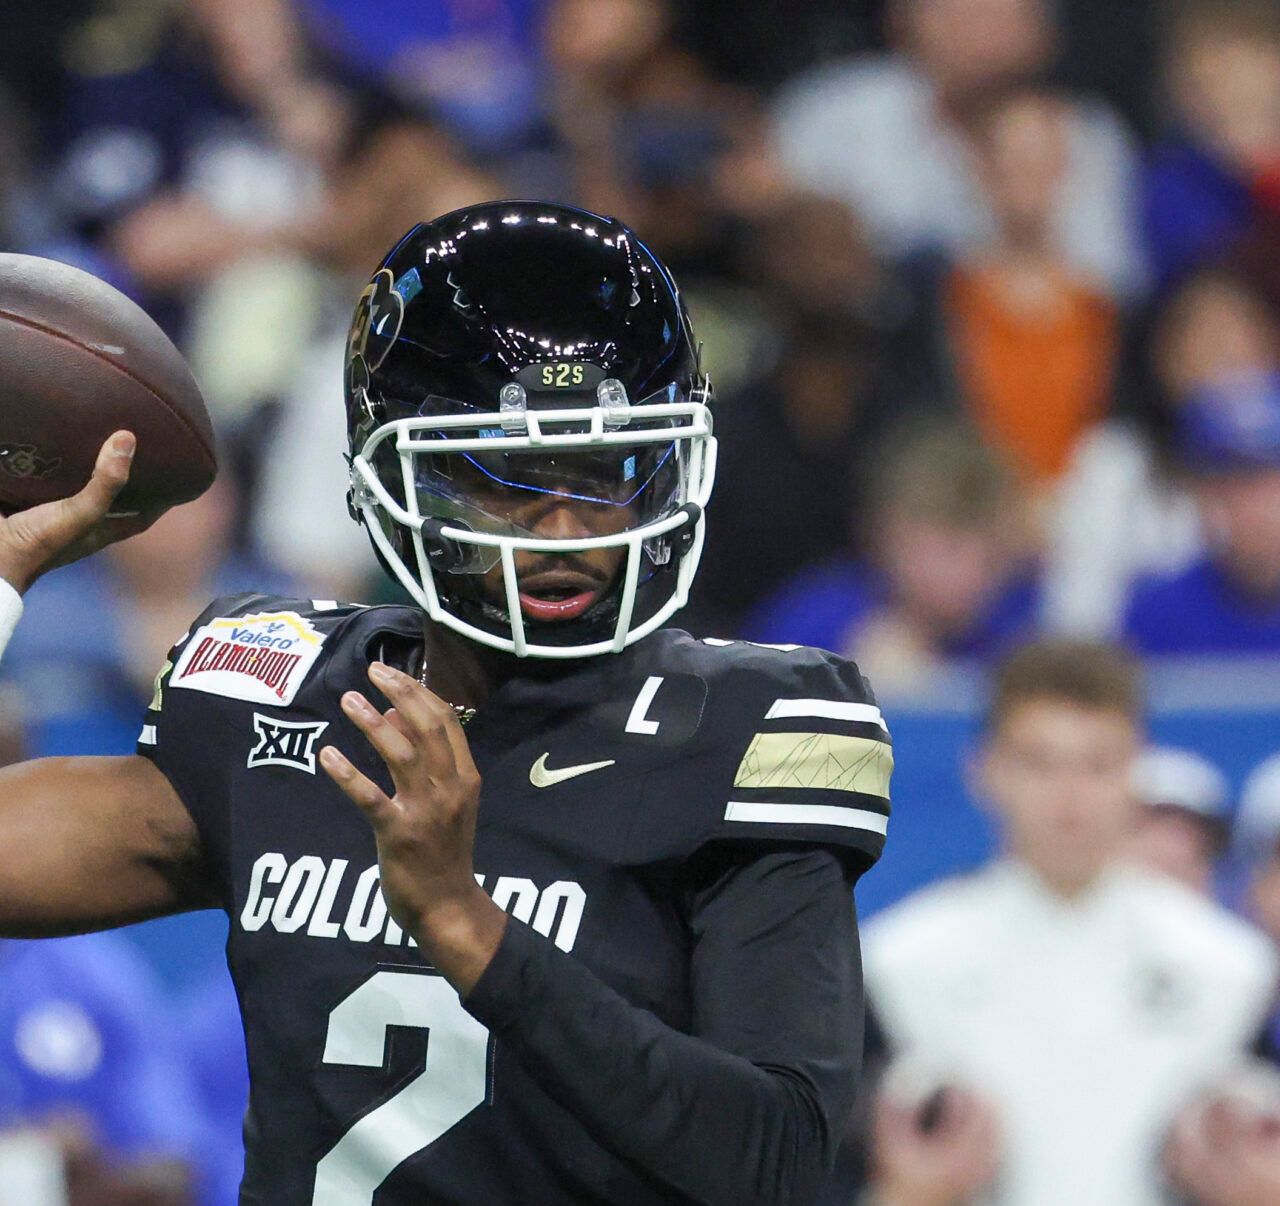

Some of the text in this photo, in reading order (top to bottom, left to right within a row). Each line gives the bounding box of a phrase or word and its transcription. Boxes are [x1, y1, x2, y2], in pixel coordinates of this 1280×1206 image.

[542, 364, 584, 388] S2S
[231, 628, 294, 650] Valero
[624, 676, 665, 735] L
[250, 716, 324, 771] XII
[239, 852, 587, 954] COLODO
